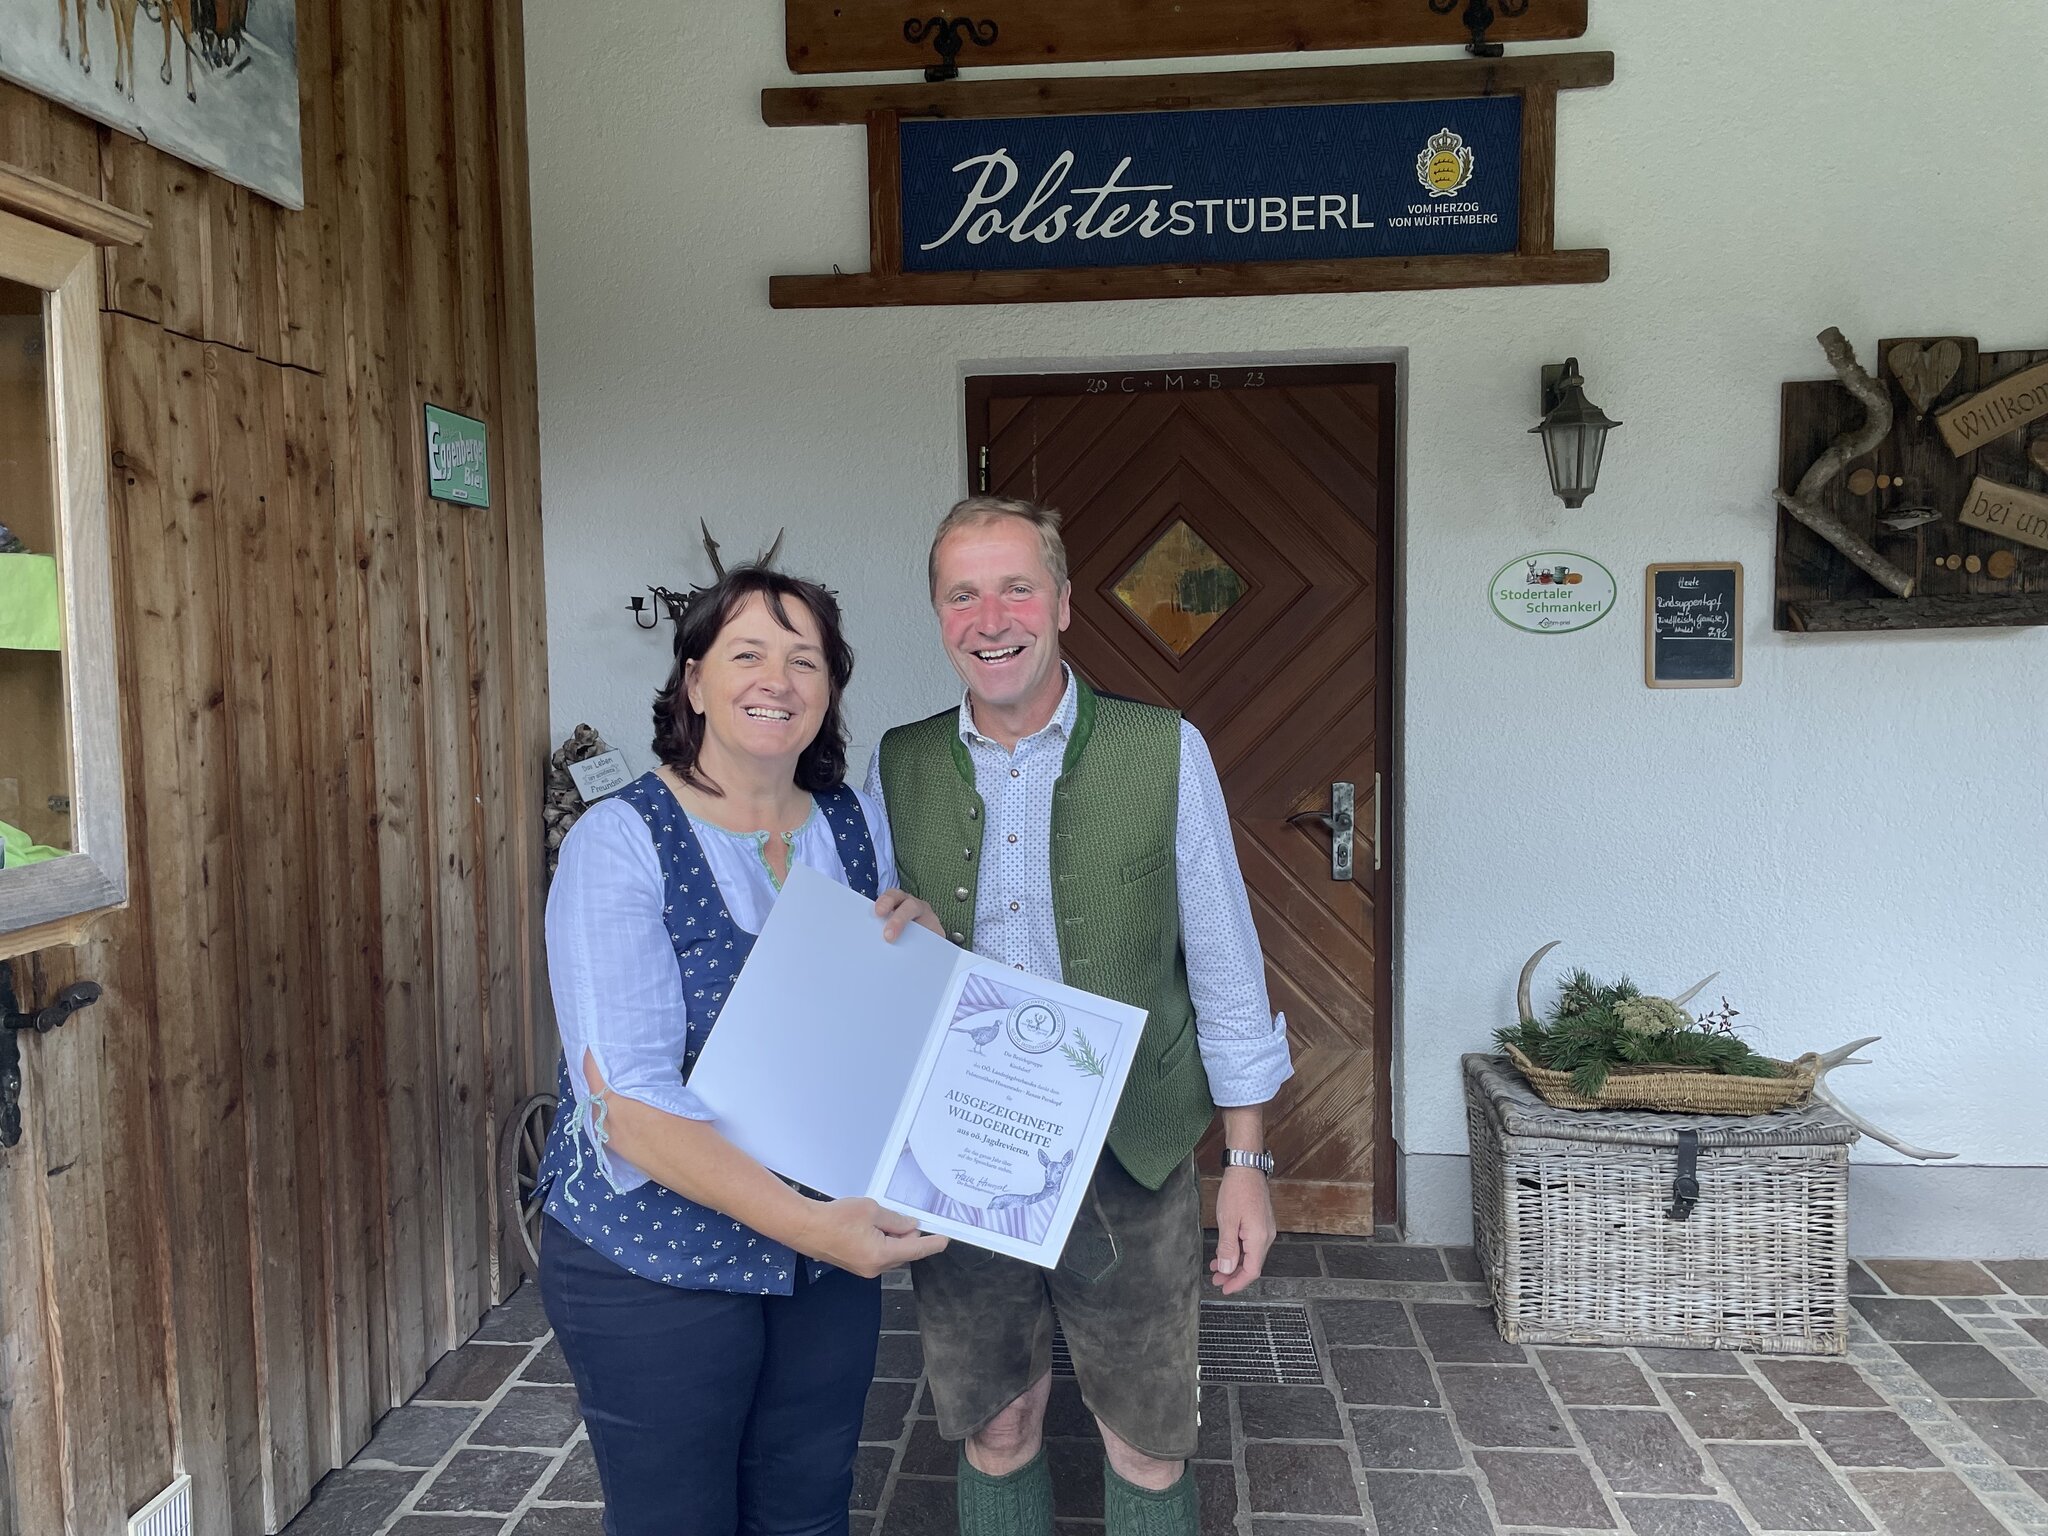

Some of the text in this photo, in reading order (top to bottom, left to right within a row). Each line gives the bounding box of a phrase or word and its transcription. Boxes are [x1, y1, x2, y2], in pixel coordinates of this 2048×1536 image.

[1408, 202, 1479, 214] VOM HERZOG
[1389, 214, 1498, 228] VON WÜRTTEMBERG
[1086, 378, 1108, 394] 20
[1121, 376, 1135, 392] C
[1165, 374, 1184, 391] M
[1209, 374, 1221, 389] B
[1244, 372, 1265, 388] 23
[464, 466, 483, 489] Bier
[1971, 491, 2048, 539] bei un
[1678, 576, 1700, 588] Heute
[1500, 588, 1573, 600] Stodertaler
[1526, 601, 1601, 613] Schmankerl
[594, 757, 614, 769] Leben
[590, 777, 623, 793] Freunden
[944, 1089, 1064, 1136] AUSGEZEICHNETE
[948, 1104, 1052, 1148] WILDGERICHTE
[956, 1127, 969, 1136] aus
[981, 1134, 1030, 1157] Jagdrevieren,
